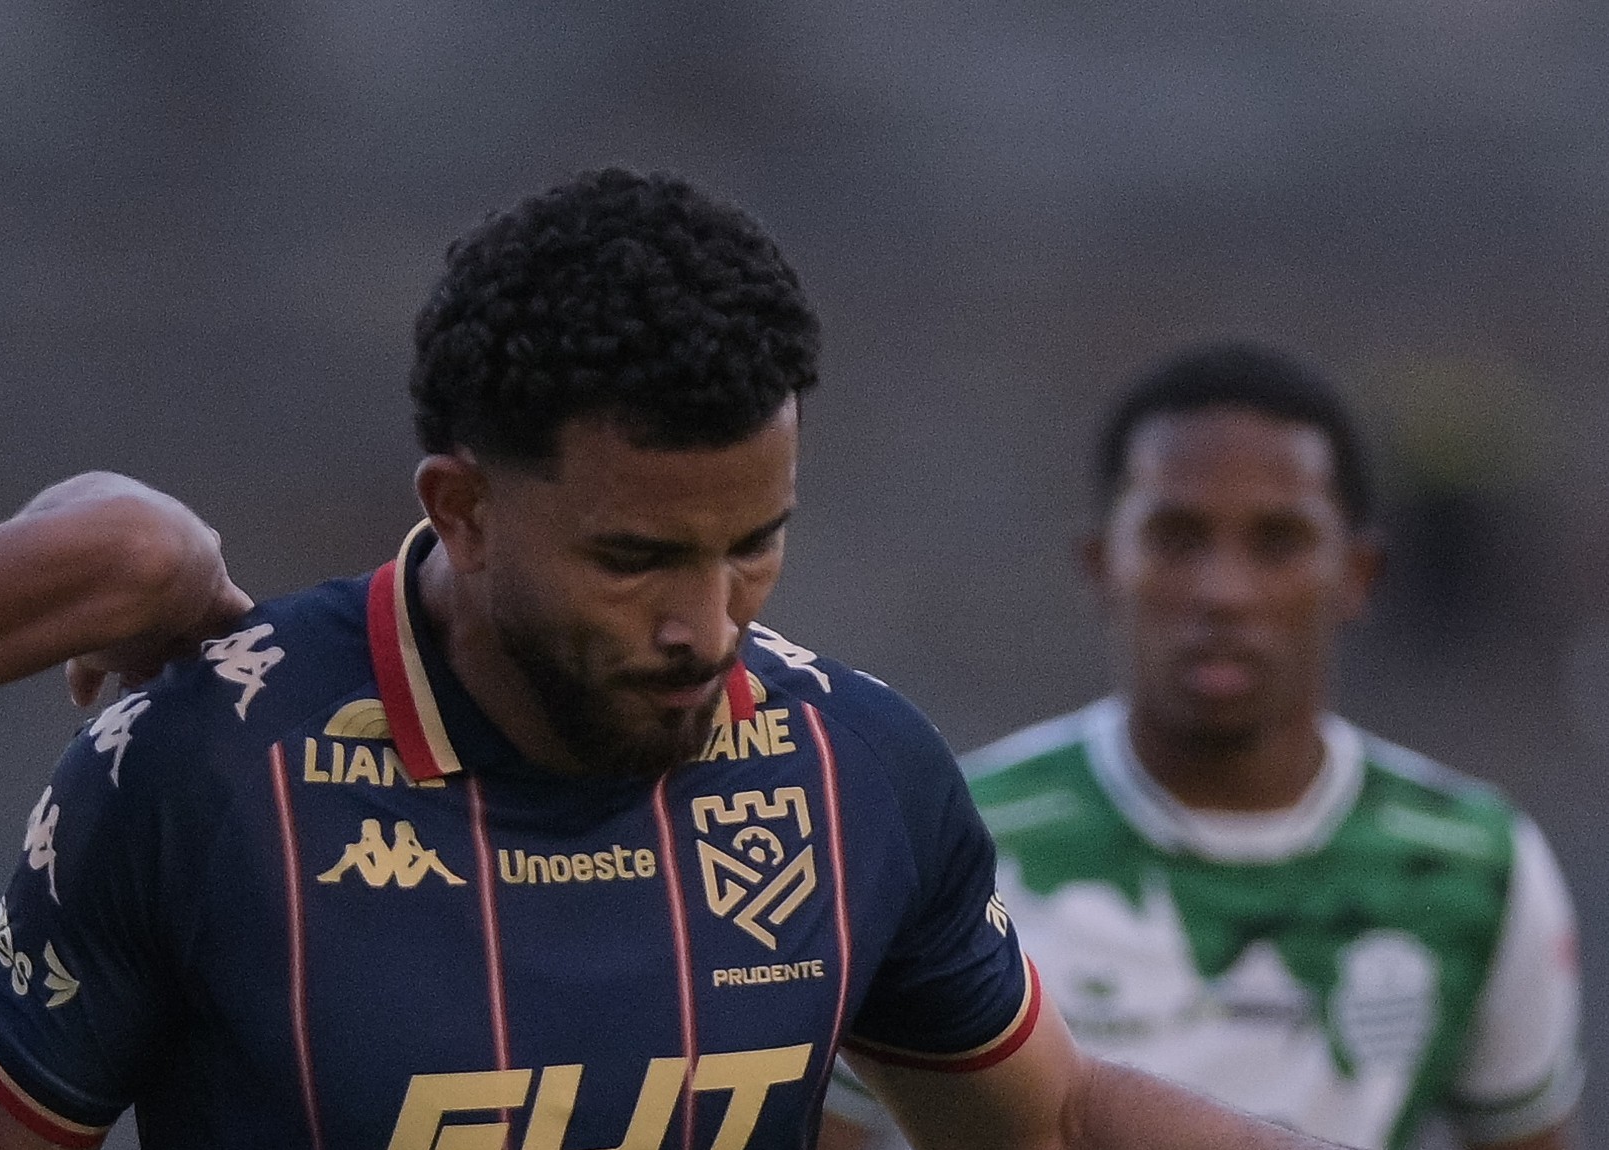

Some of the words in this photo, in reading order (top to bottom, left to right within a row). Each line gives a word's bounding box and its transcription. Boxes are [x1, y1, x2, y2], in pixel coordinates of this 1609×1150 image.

[303, 736, 447, 788] LIAN
[497, 844, 657, 884] Unoeste
[712, 959, 825, 987] PRUDENTE
